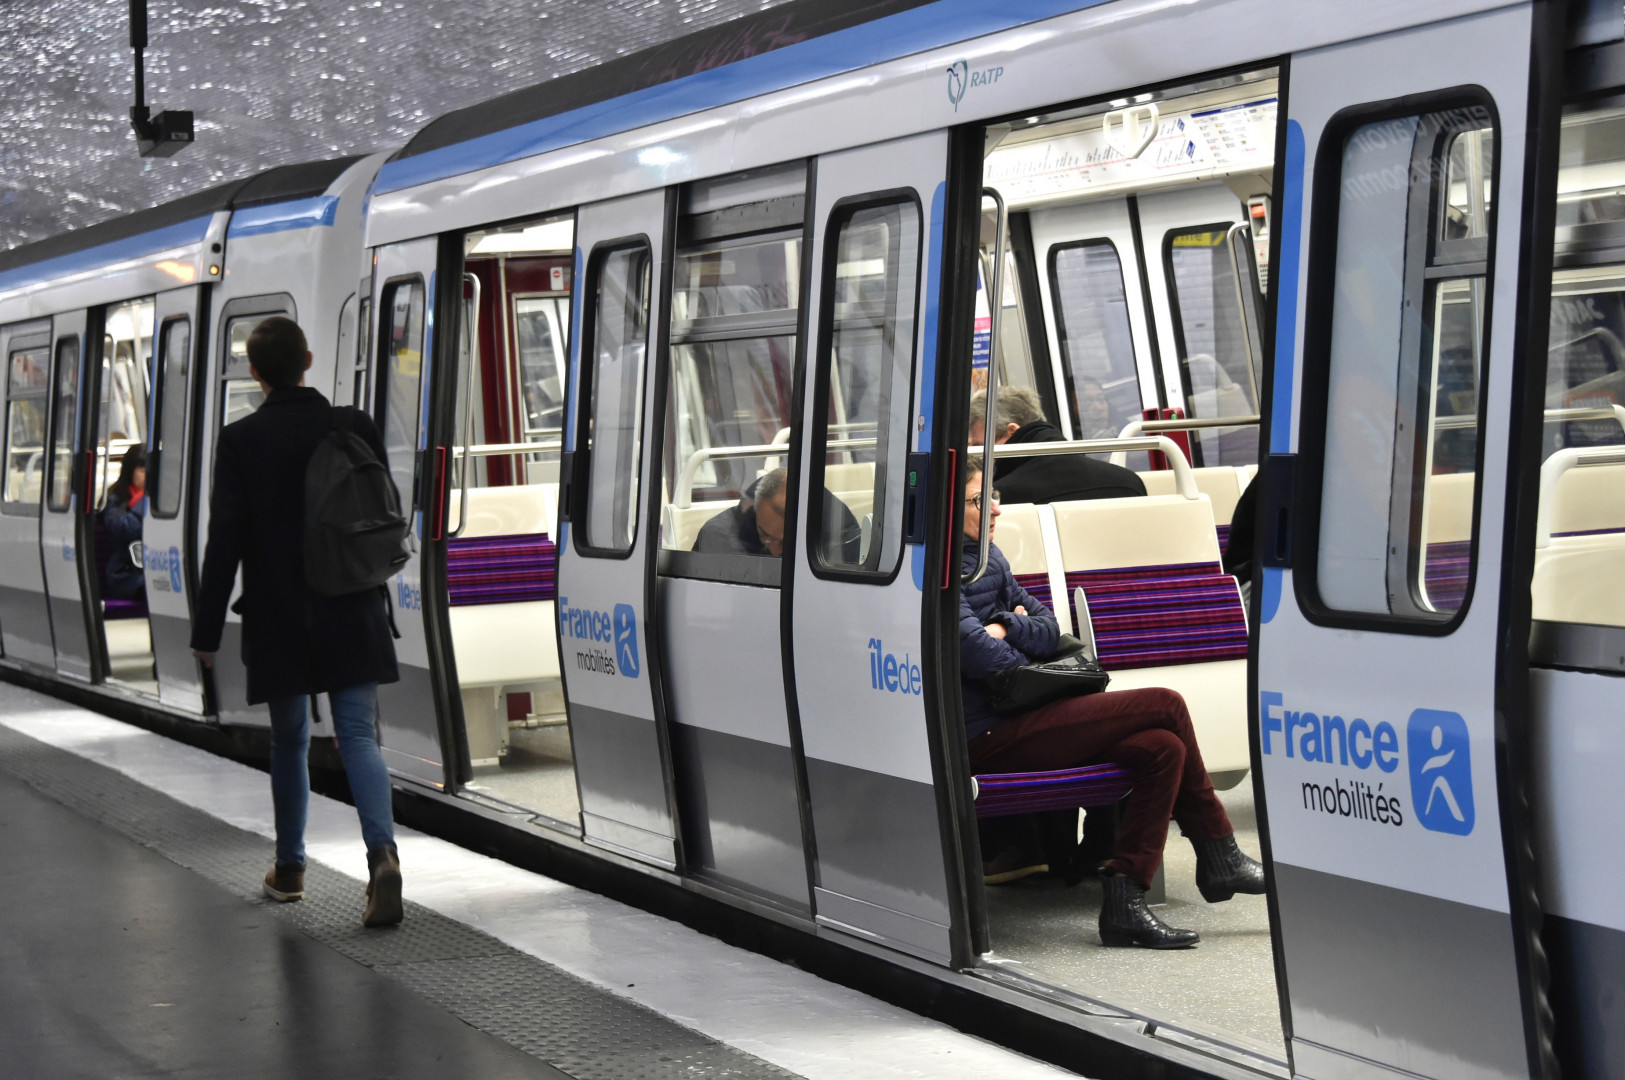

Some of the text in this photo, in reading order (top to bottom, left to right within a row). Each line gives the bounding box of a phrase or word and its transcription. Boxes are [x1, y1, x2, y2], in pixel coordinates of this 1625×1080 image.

[970, 66, 1004, 88] RATP
[559, 596, 611, 643] France
[577, 648, 615, 675] mobilités
[1260, 690, 1399, 773] France
[1302, 778, 1403, 827] mobilités
